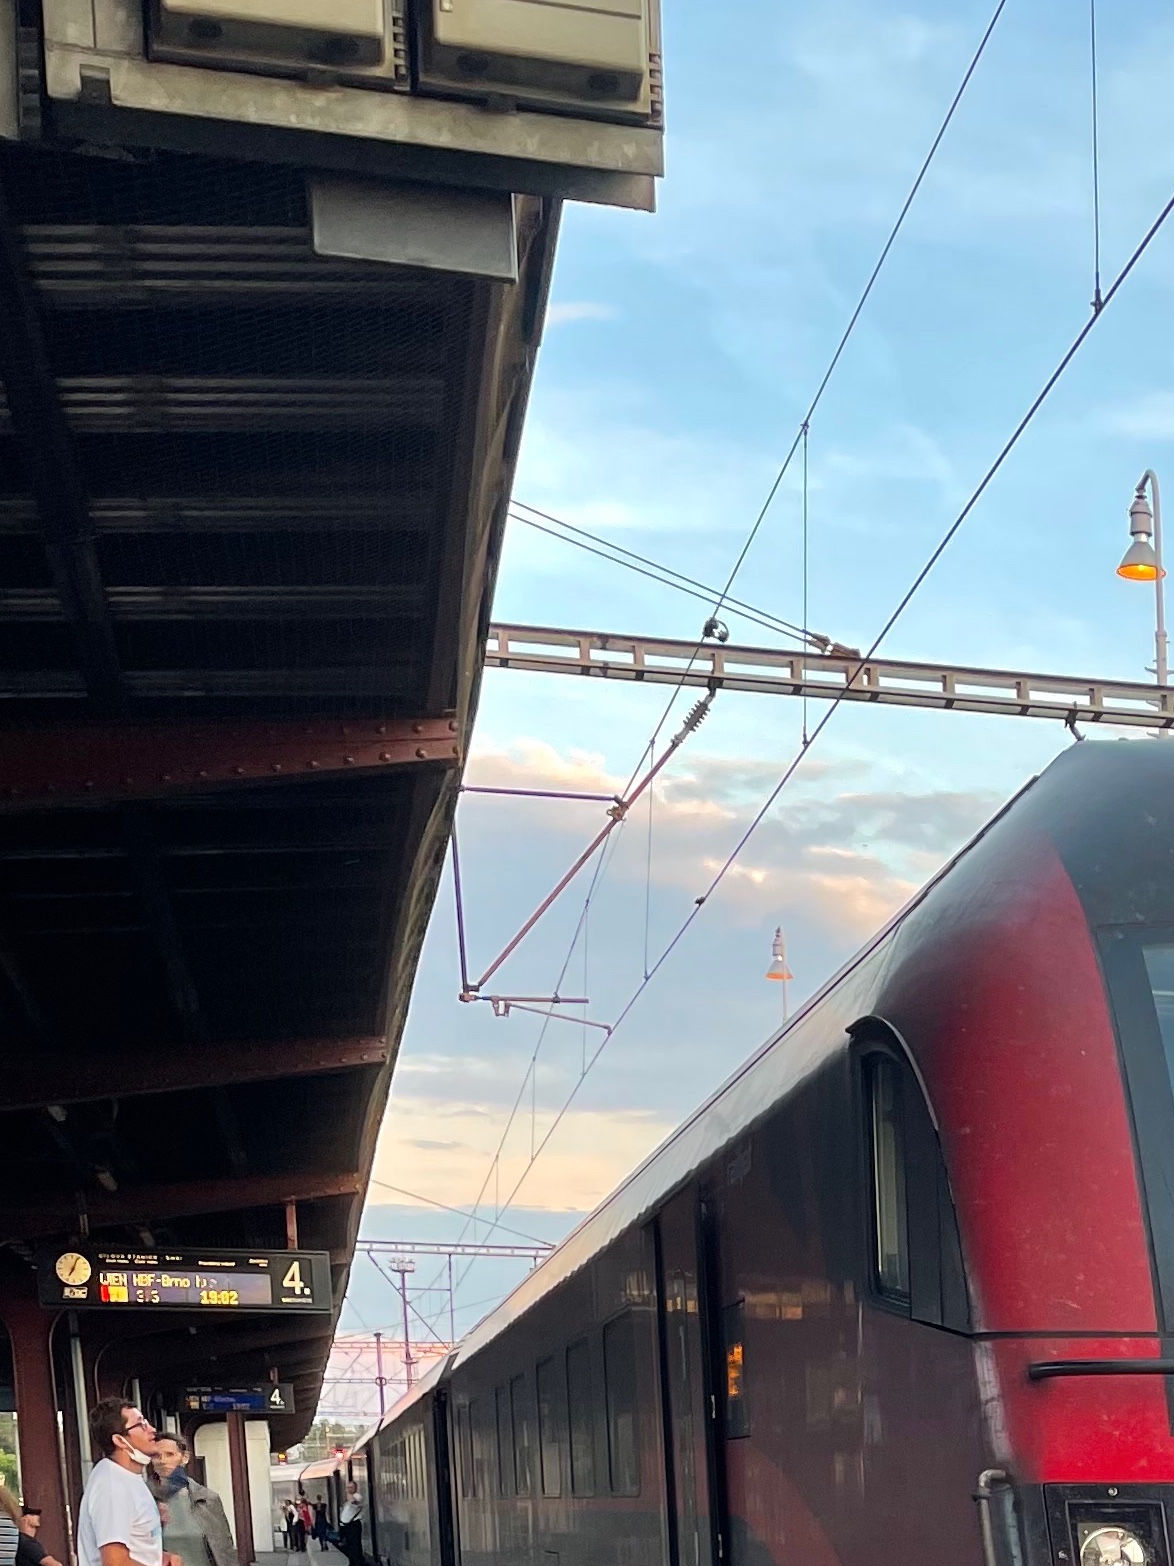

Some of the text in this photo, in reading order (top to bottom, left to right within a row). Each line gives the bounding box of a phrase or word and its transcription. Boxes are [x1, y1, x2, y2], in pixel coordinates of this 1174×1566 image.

[99, 1272, 127, 1286] WIEN
[282, 1260, 311, 1295] 4.
[200, 1290, 239, 1305] 19:02
